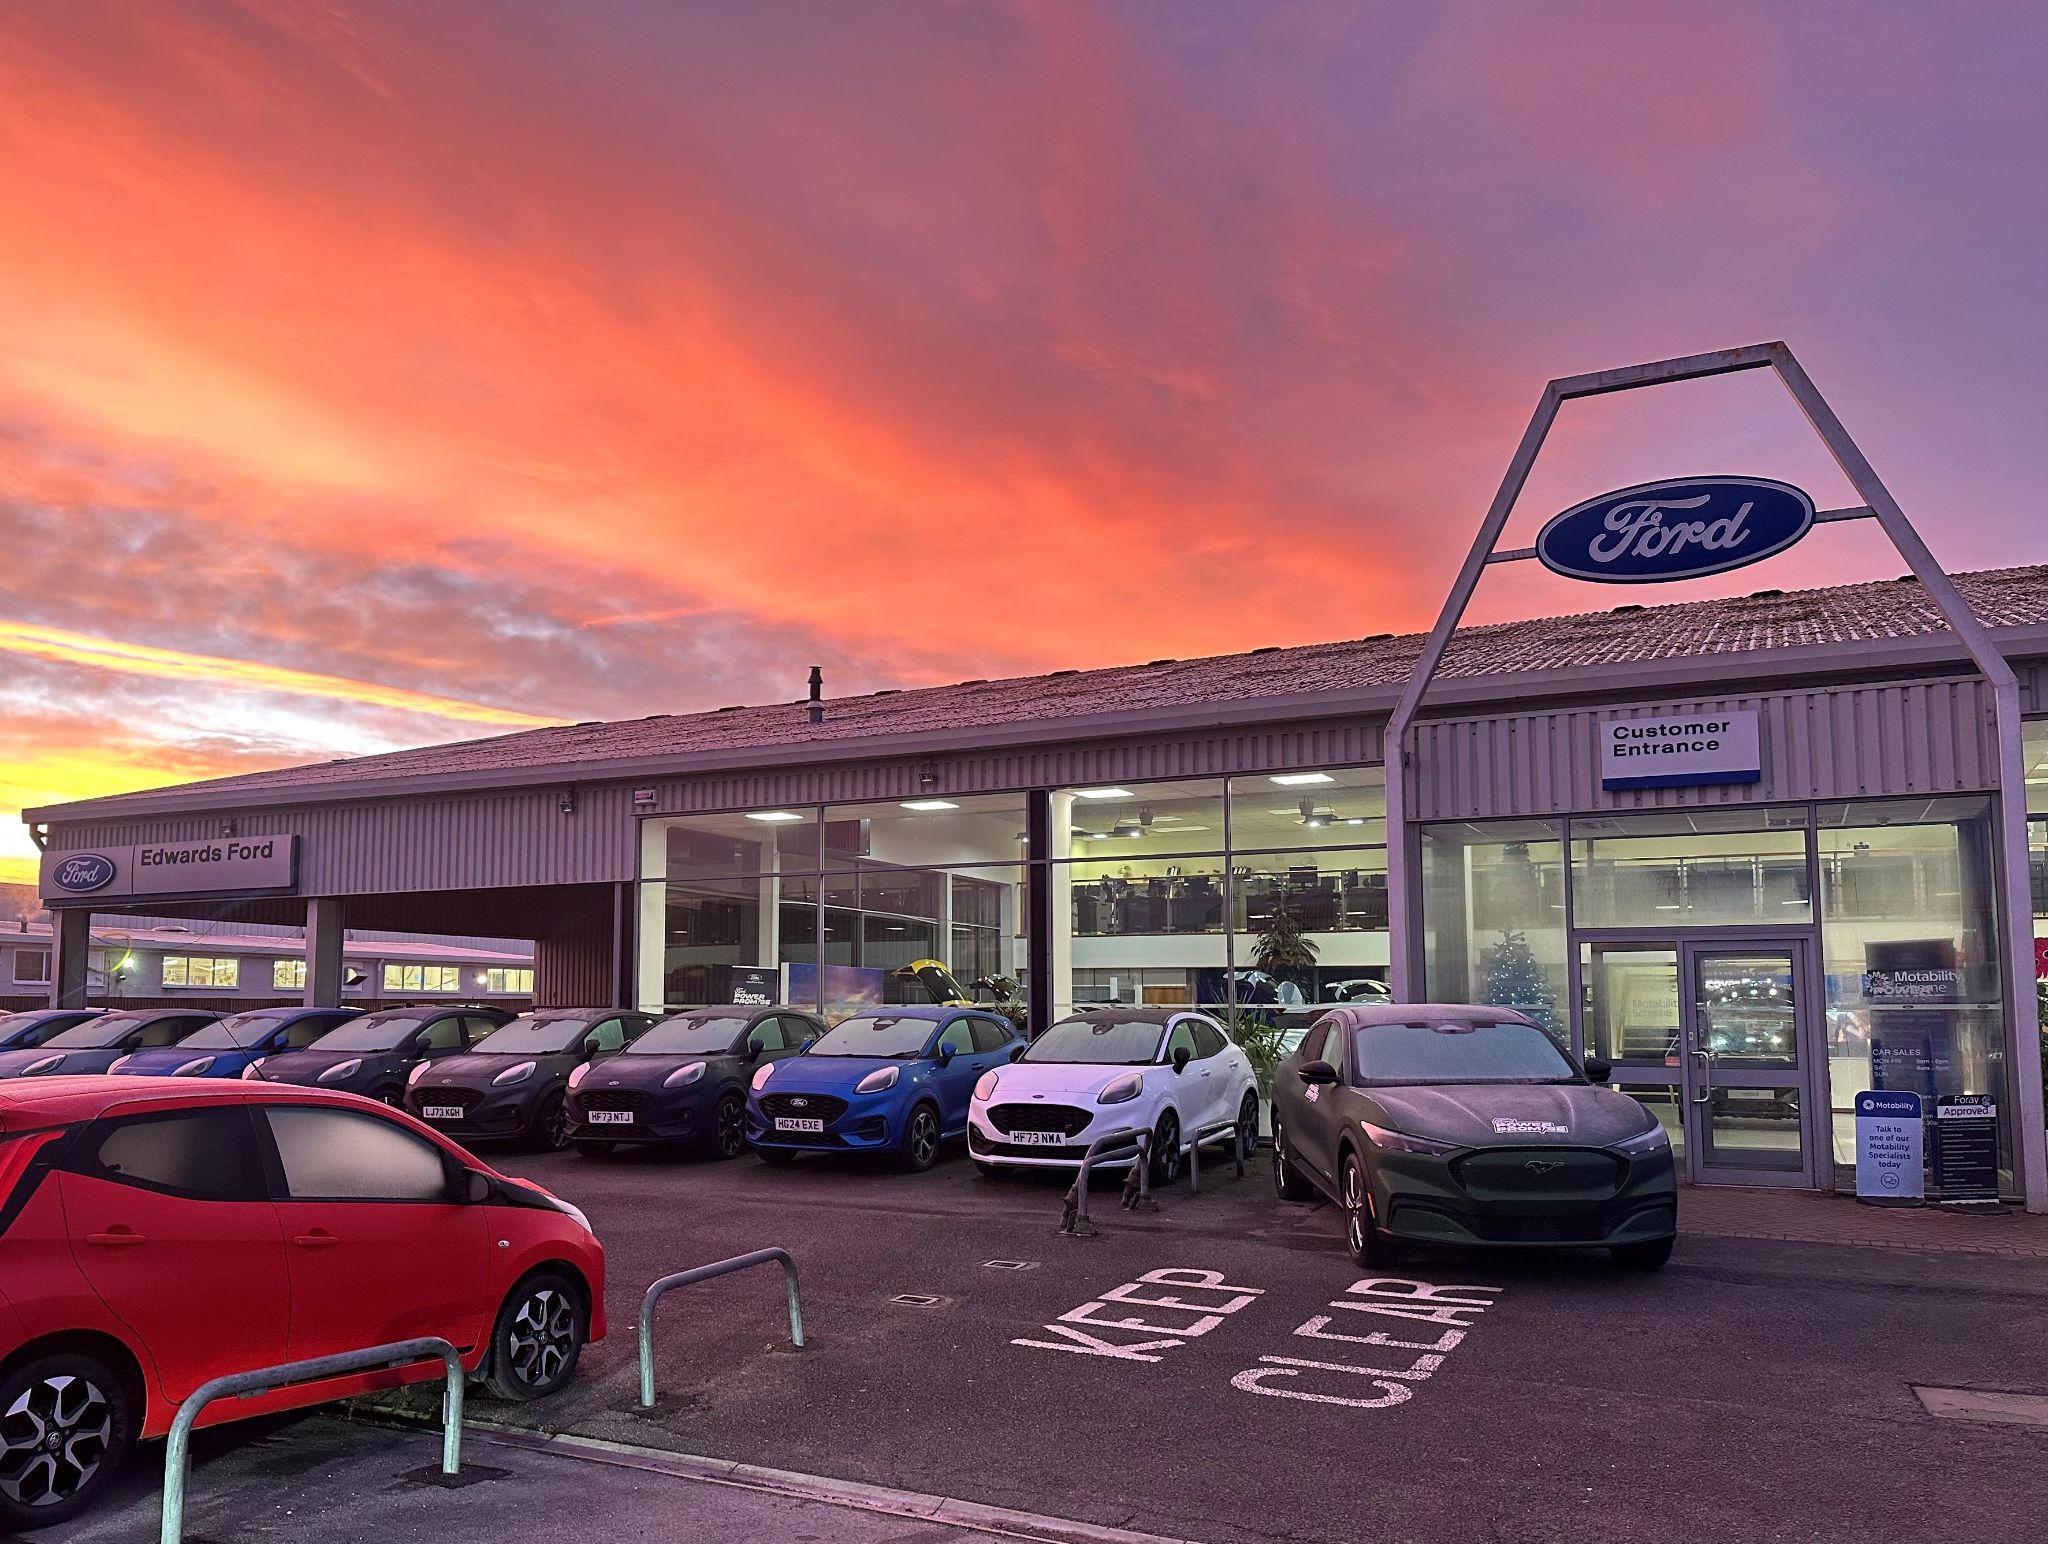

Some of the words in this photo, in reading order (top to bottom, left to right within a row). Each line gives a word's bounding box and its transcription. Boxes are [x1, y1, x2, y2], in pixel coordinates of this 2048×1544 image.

[1588, 493, 1754, 563] Ford
[1613, 720, 1731, 740] Customer
[1613, 738, 1720, 757] Entrance
[140, 846, 222, 866] Edwards
[227, 840, 274, 860] Ford
[62, 860, 99, 884] Ford
[1894, 970, 1960, 983] Motability
[734, 993, 766, 1001] POWER
[1633, 999, 1678, 1008] Motabilit
[1954, 1095, 1979, 1104] Foray
[1876, 1101, 1914, 1111] Motability
[1943, 1106, 1989, 1116] Approved
[425, 1107, 444, 1117] LJ73
[445, 1107, 460, 1117] KGH
[591, 1112, 613, 1122] HF73
[613, 1112, 630, 1122] NTJ
[778, 1119, 800, 1129] HG24
[802, 1120, 820, 1130] EXE
[1876, 1125, 1891, 1133] Talk
[1013, 1132, 1039, 1143] HF73
[1041, 1133, 1062, 1144] NWA
[1869, 1143, 1910, 1152] Motability
[1868, 1151, 1911, 1161] Specialists
[1878, 1160, 1902, 1169] today
[1009, 1267, 1267, 1364] KEEP
[1230, 1277, 1504, 1408] CLEAR
